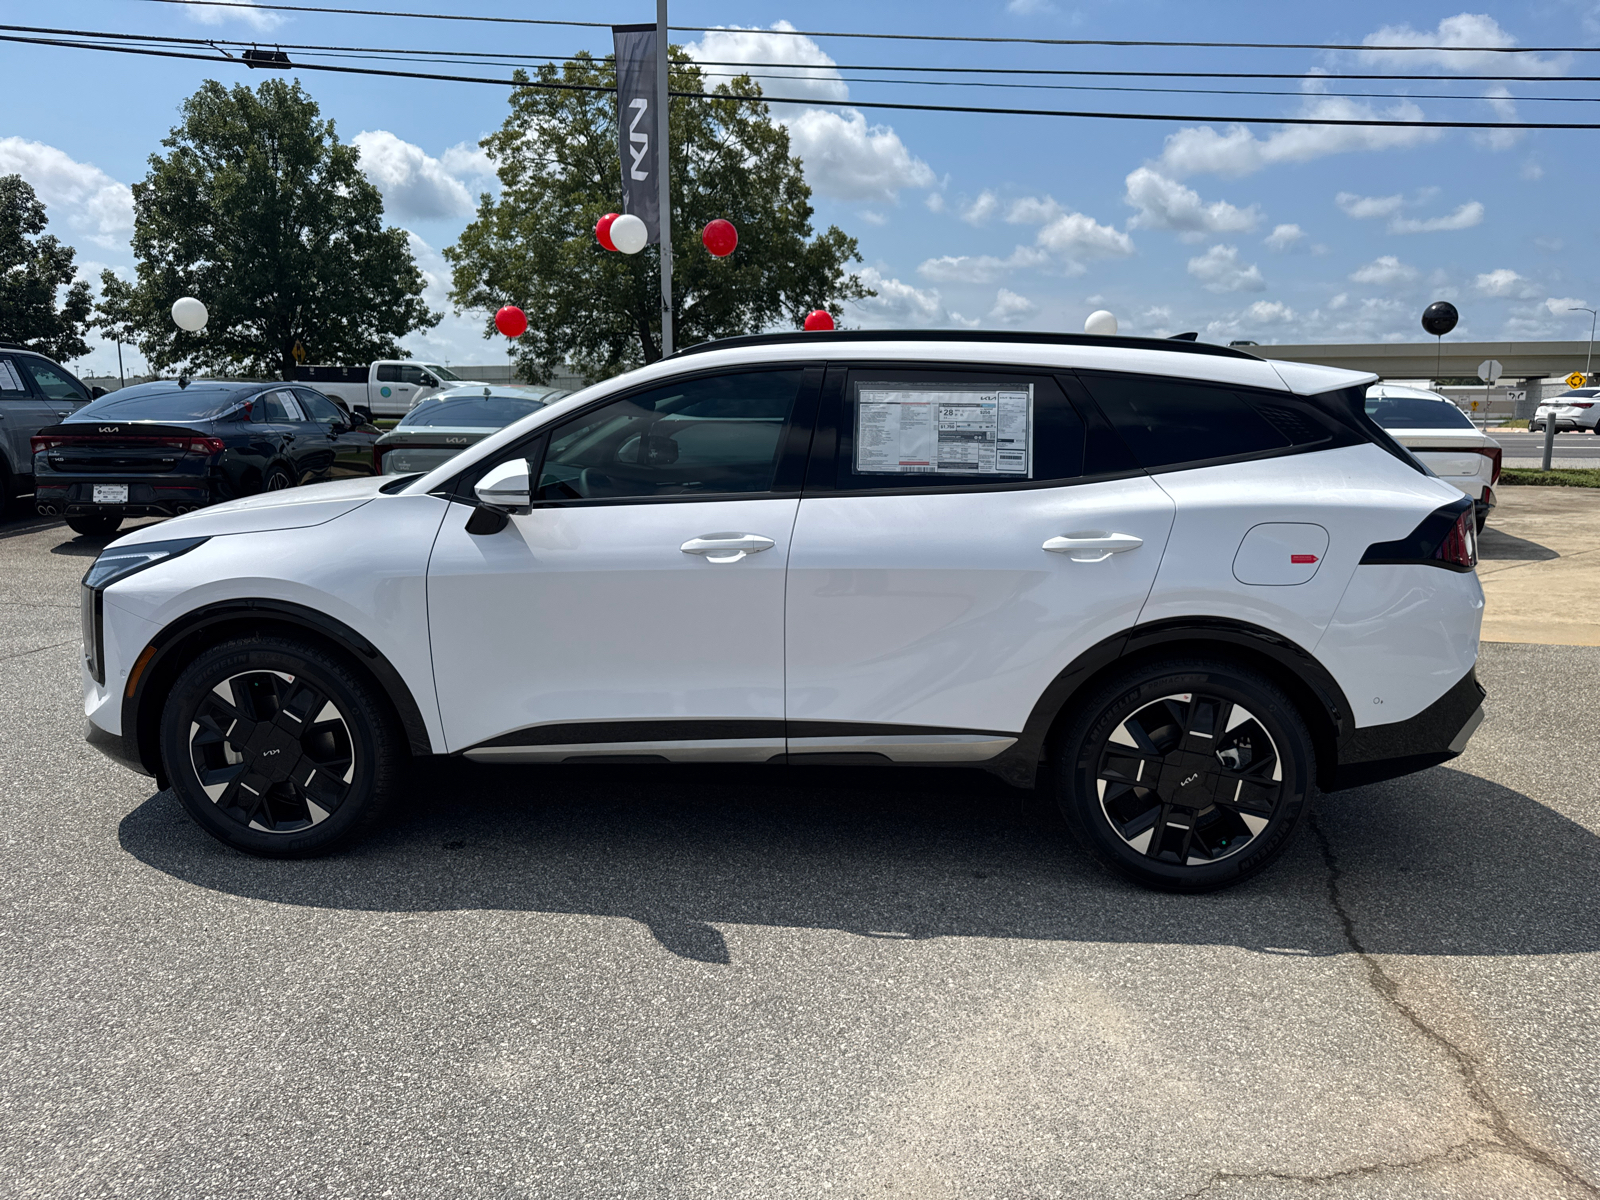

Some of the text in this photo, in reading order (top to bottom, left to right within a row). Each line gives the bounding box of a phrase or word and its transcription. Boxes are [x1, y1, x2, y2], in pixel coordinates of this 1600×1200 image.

[628, 98, 650, 181] KIA
[194, 654, 249, 686] MICHELIN
[1090, 689, 1141, 743] MICHELIN
[1148, 676, 1186, 689] PRIMACY
[263, 748, 281, 757] KIA
[1180, 772, 1199, 787] KIA
[1241, 819, 1291, 871] MICHELIN
